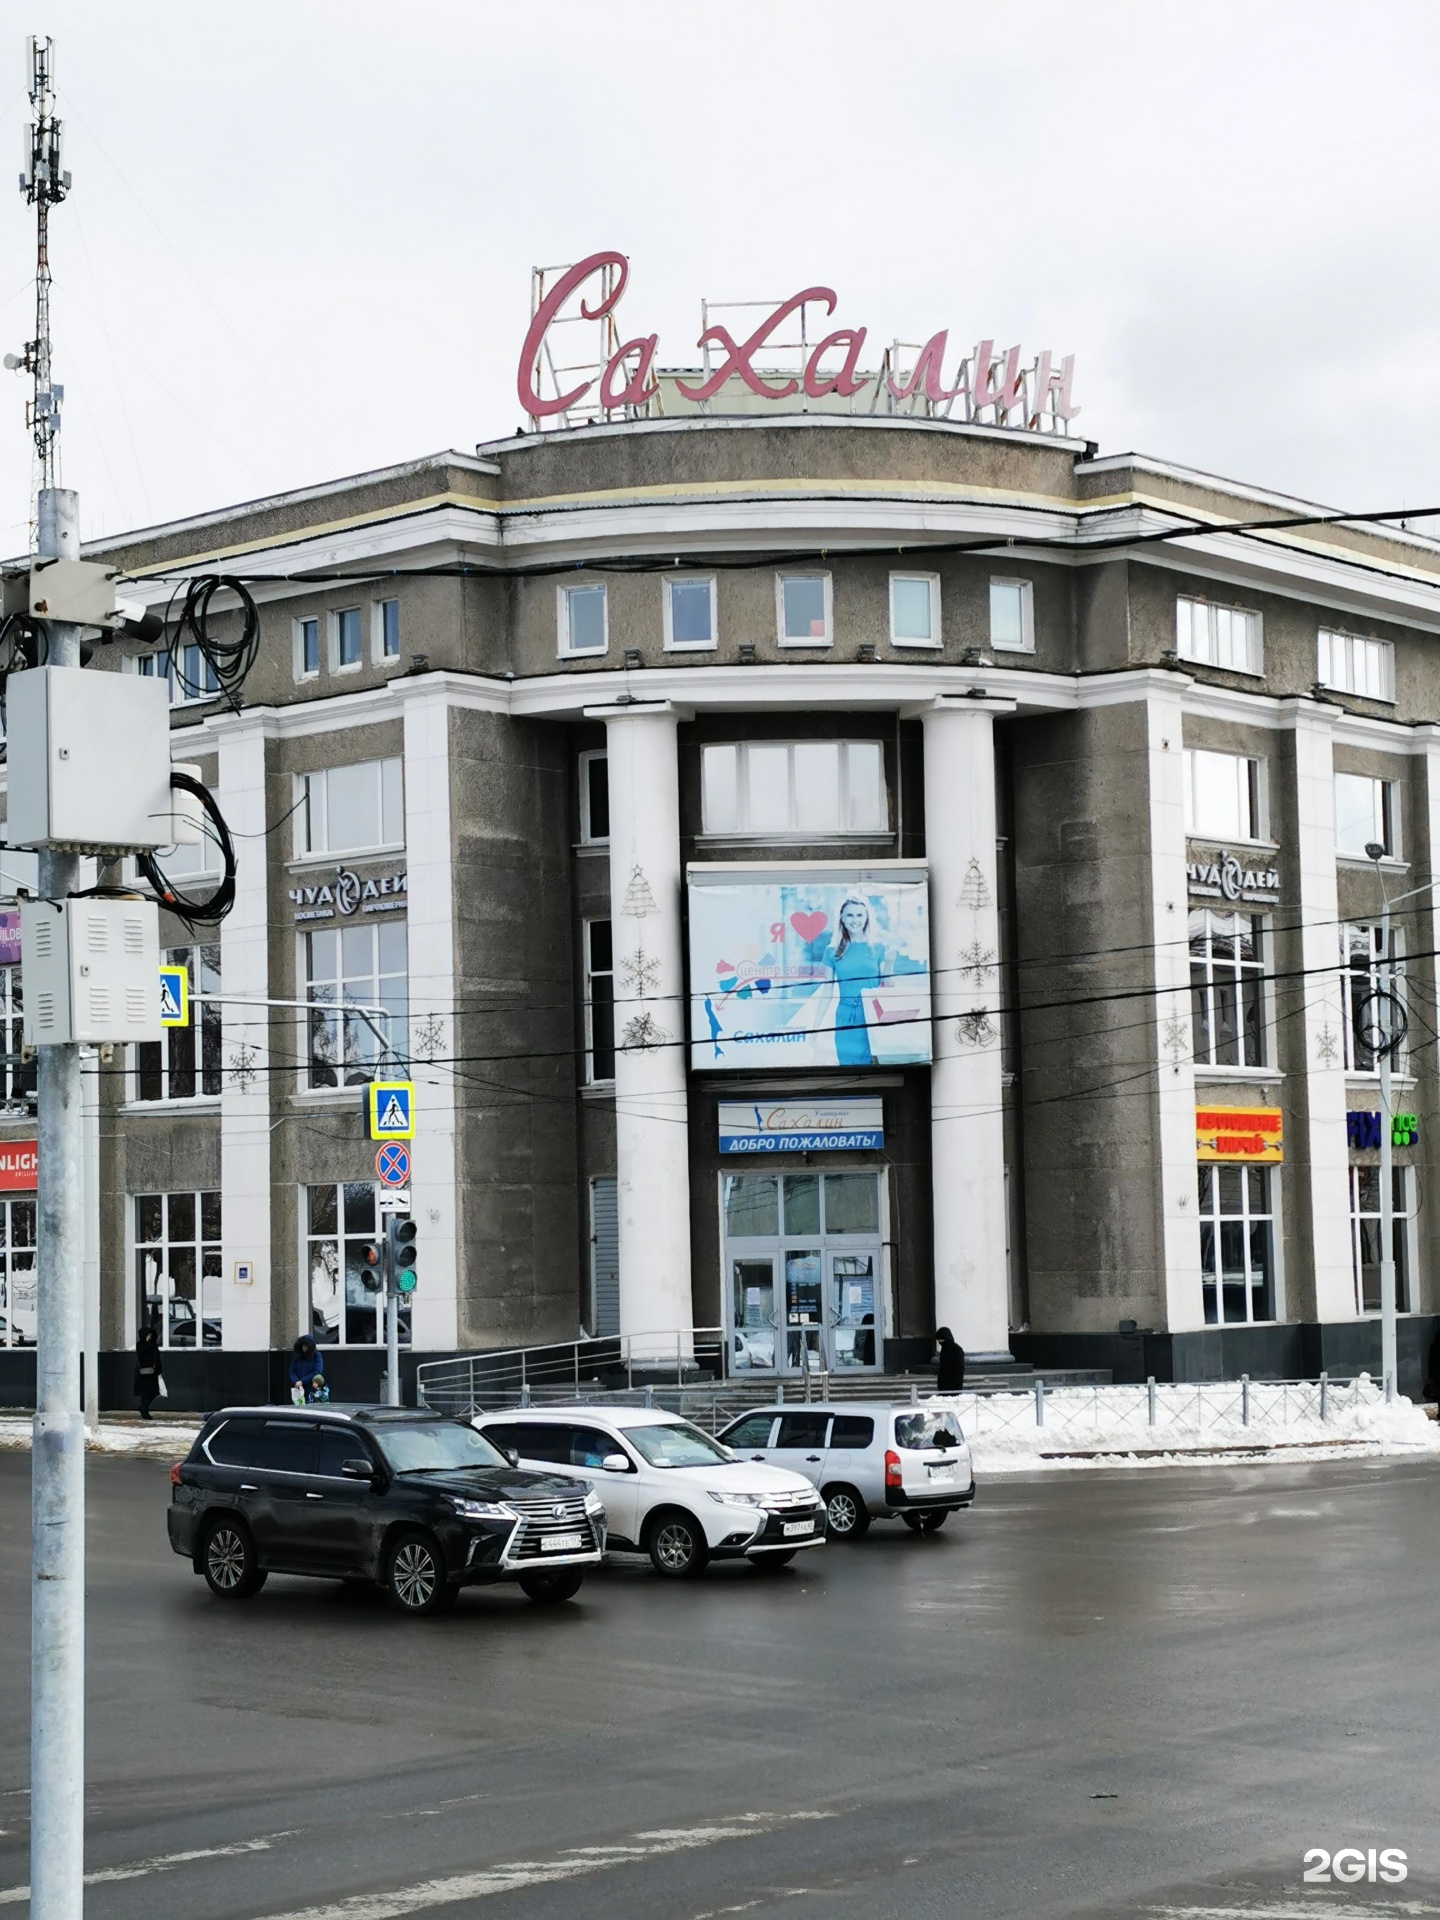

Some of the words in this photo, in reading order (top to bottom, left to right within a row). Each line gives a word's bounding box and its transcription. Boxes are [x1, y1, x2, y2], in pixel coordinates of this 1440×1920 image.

[517, 251, 1082, 419] Сахалин
[766, 1107, 844, 1130] Сахалин
[728, 1137, 776, 1151] ДОБРО
[778, 1134, 877, 1150] ПОЖАЛОВАТЬ!
